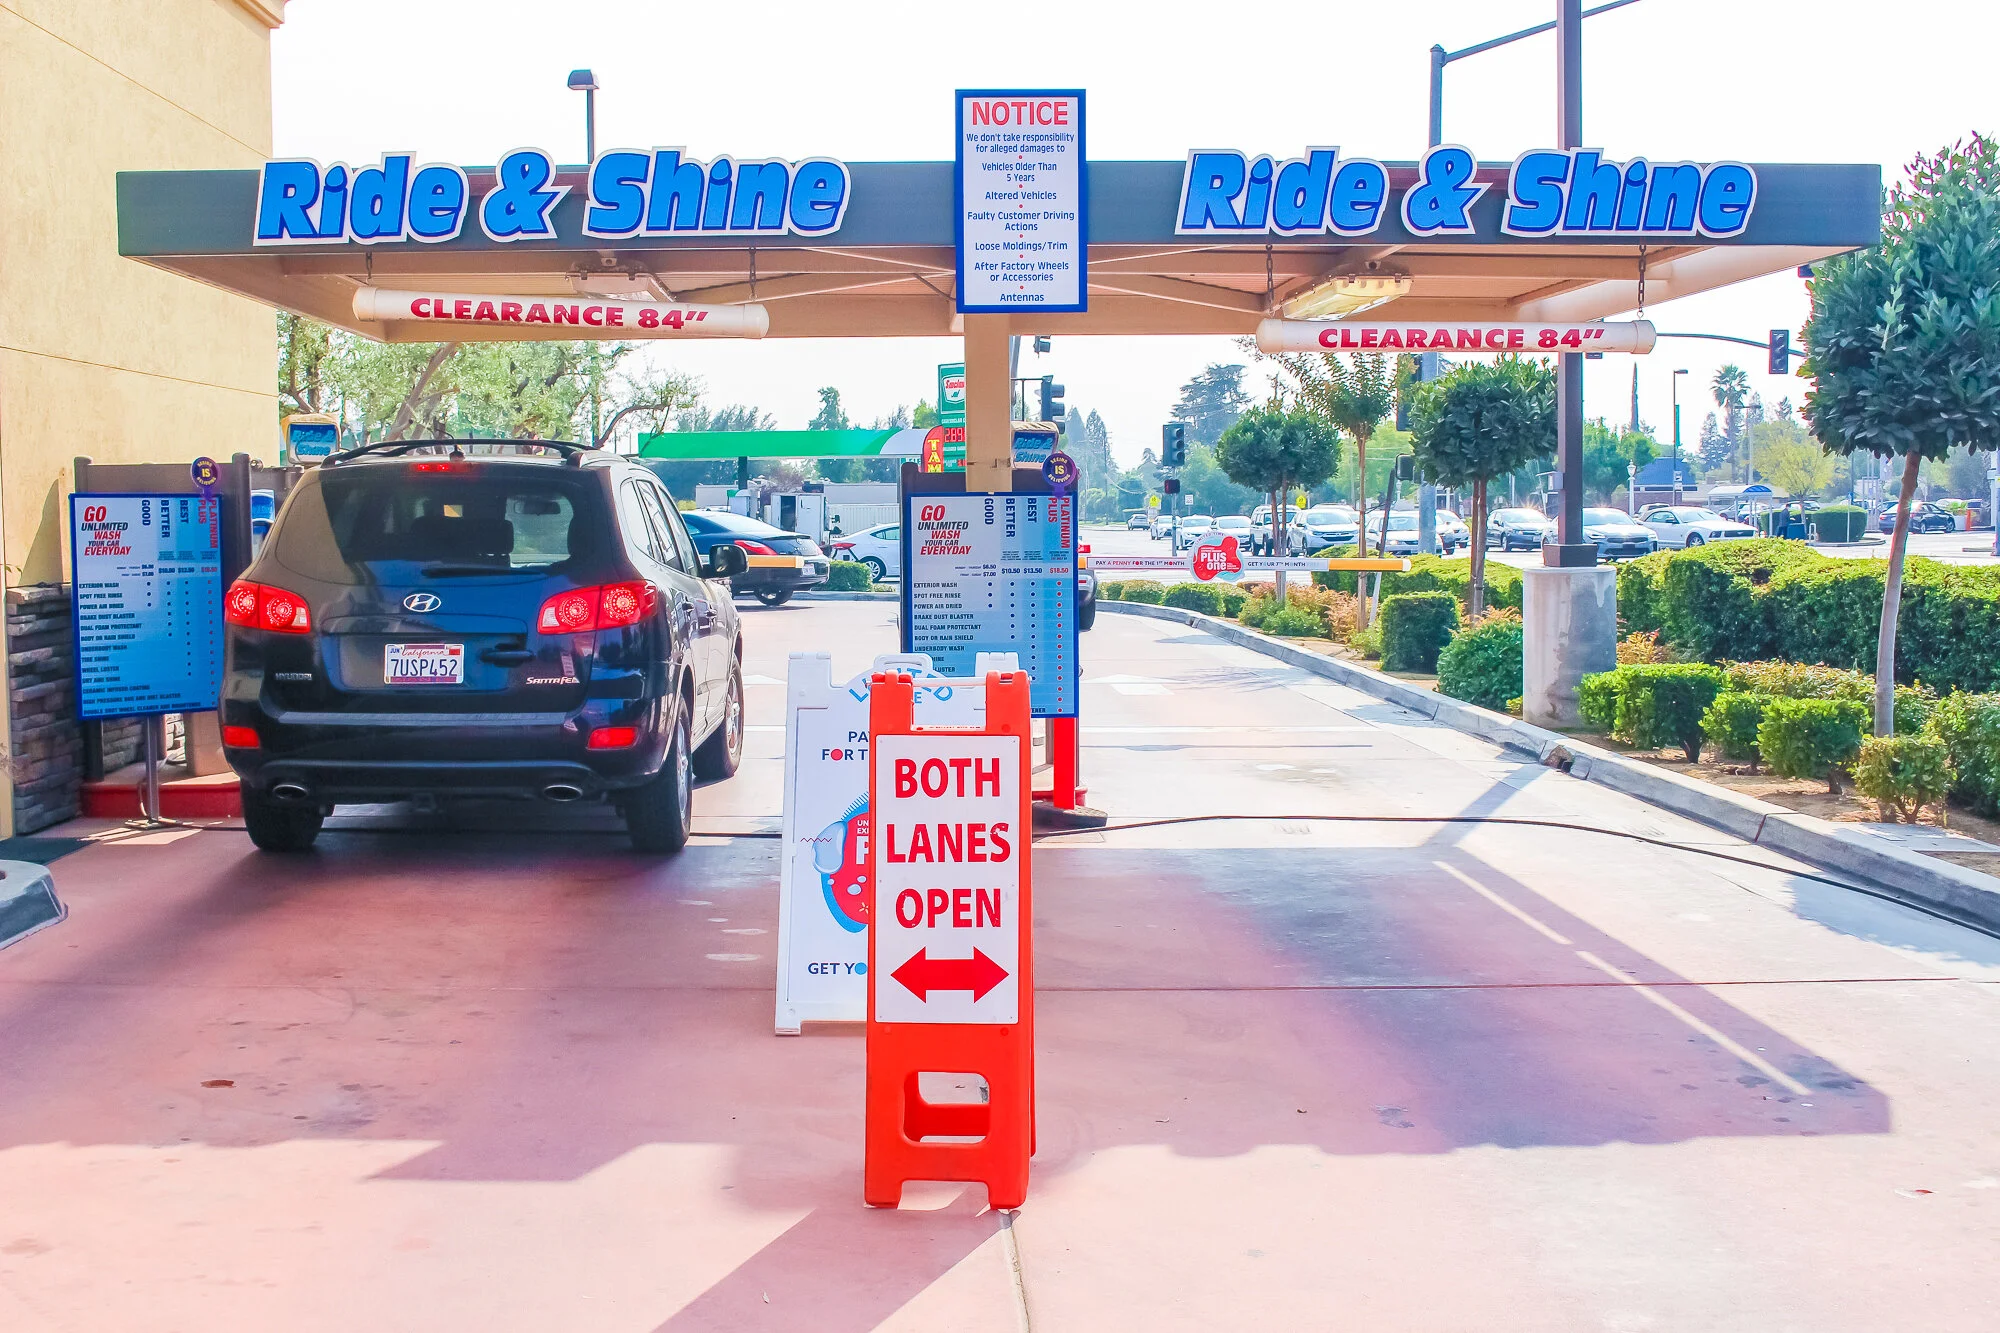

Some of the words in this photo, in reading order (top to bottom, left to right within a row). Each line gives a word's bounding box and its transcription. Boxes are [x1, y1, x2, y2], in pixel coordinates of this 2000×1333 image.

[972, 102, 1068, 126] NOTICE
[966, 133, 979, 142] We
[980, 133, 1001, 142] don't
[1003, 133, 1021, 142] take
[1022, 133, 1075, 143] responsibility
[976, 144, 988, 153] for
[990, 144, 1018, 154] alleged
[1020, 144, 1055, 154] damages
[1056, 145, 1066, 153] to
[982, 162, 1013, 171] Vehicles
[1015, 162, 1036, 171] Older
[1038, 162, 1057, 171] Than
[1006, 173, 1012, 182] 5
[1013, 173, 1035, 182] Years
[255, 154, 467, 242] Ride
[483, 150, 570, 239] &
[586, 148, 849, 236] Shine
[985, 191, 1018, 200] Altered
[1021, 191, 1057, 200] Vehicles
[1180, 149, 1387, 234] Ride
[1403, 146, 1489, 234] &
[1506, 149, 1756, 235] Shine
[967, 211, 995, 221] Faulty
[997, 211, 1041, 220] Customer
[1043, 211, 1075, 221] Driving
[1005, 222, 1038, 231] Actions
[975, 242, 1000, 251] Loose
[974, 262, 999, 271] After
[1001, 262, 1035, 272] Factory
[1038, 262, 1069, 271] Wheels
[990, 274, 999, 282] or
[1002, 273, 1054, 282] Accessories
[1000, 293, 1044, 302] Antennas
[411, 298, 624, 326] CLEARANCE
[1318, 328, 1524, 349] CLEARANCE
[1015, 438, 1041, 449] Ride
[1042, 438, 1053, 449] &
[1015, 452, 1046, 463] Shine
[202, 468, 210, 477] IS
[1055, 465, 1065, 474] IS
[84, 506, 107, 522] GO
[142, 500, 151, 526] GOOD
[180, 500, 189, 524] BEST
[198, 499, 207, 524] PLUS
[921, 505, 945, 521] GO
[984, 498, 994, 525] GOOD
[1028, 498, 1037, 523] BEST
[1048, 498, 1057, 523] PLUS
[160, 500, 170, 538] BETTER
[209, 499, 218, 548] PLATINUM
[1006, 498, 1015, 538] BETTER
[1060, 497, 1071, 548] PLATINUM
[81, 522, 128, 531] UNLIMITED
[918, 521, 968, 530] UNLIMITED
[94, 531, 121, 539] WASH
[931, 530, 960, 539] WASH
[84, 547, 131, 556] EVERYDAY
[920, 546, 972, 555] EVERYDAY
[1201, 552, 1227, 562] PLUS
[1207, 562, 1227, 570] one
[402, 648, 445, 658] California
[391, 659, 457, 676] 7USP452
[848, 731, 869, 742] PA
[822, 748, 854, 761] FOR
[895, 758, 1000, 798] BOTH
[886, 823, 1011, 864] LANES
[895, 888, 1002, 928] OPEN
[808, 963, 840, 975] GET
